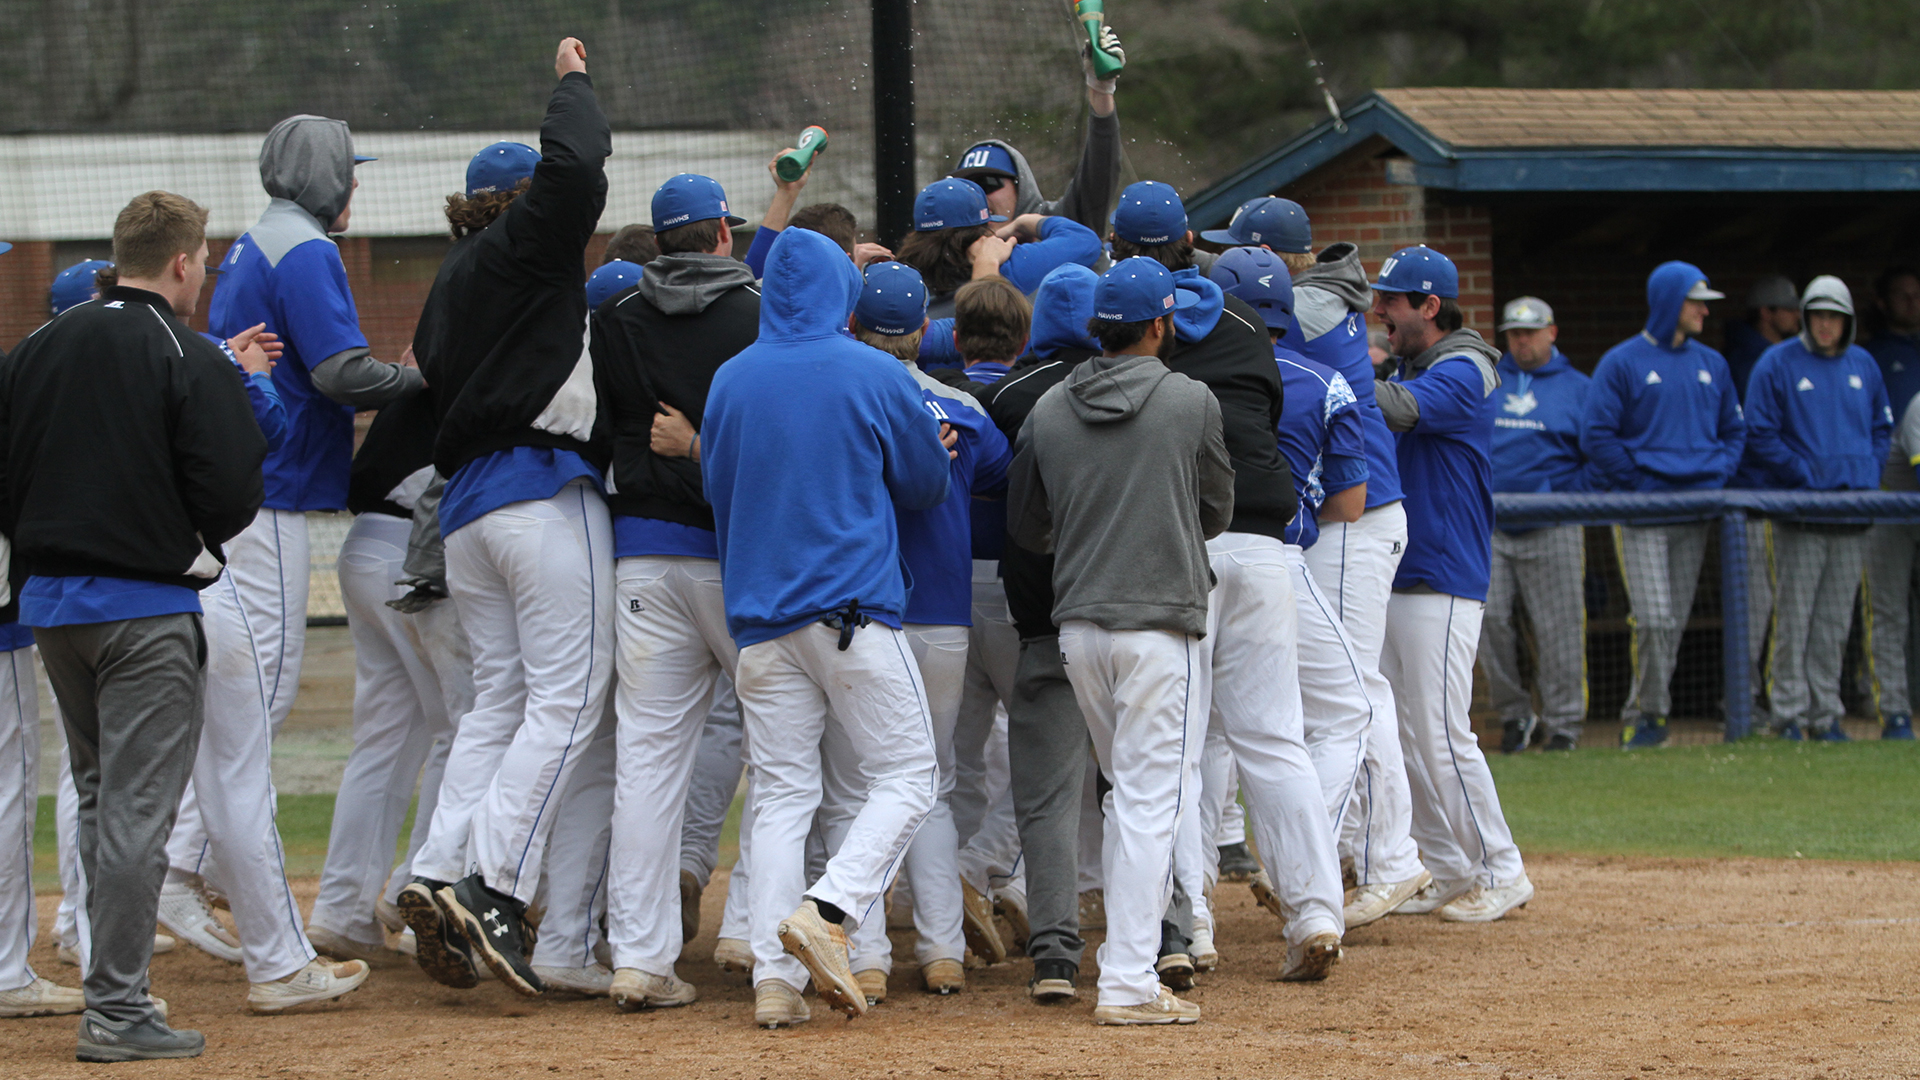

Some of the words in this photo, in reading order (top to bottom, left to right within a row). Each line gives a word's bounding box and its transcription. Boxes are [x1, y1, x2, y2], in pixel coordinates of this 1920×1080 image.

[963, 150, 990, 168] CU
[663, 213, 690, 226] HAWKS
[920, 219, 944, 228] HAWKS
[1140, 235, 1169, 243] HAWKS
[1097, 311, 1123, 320] HAWKS
[875, 325, 905, 334] HAWKS
